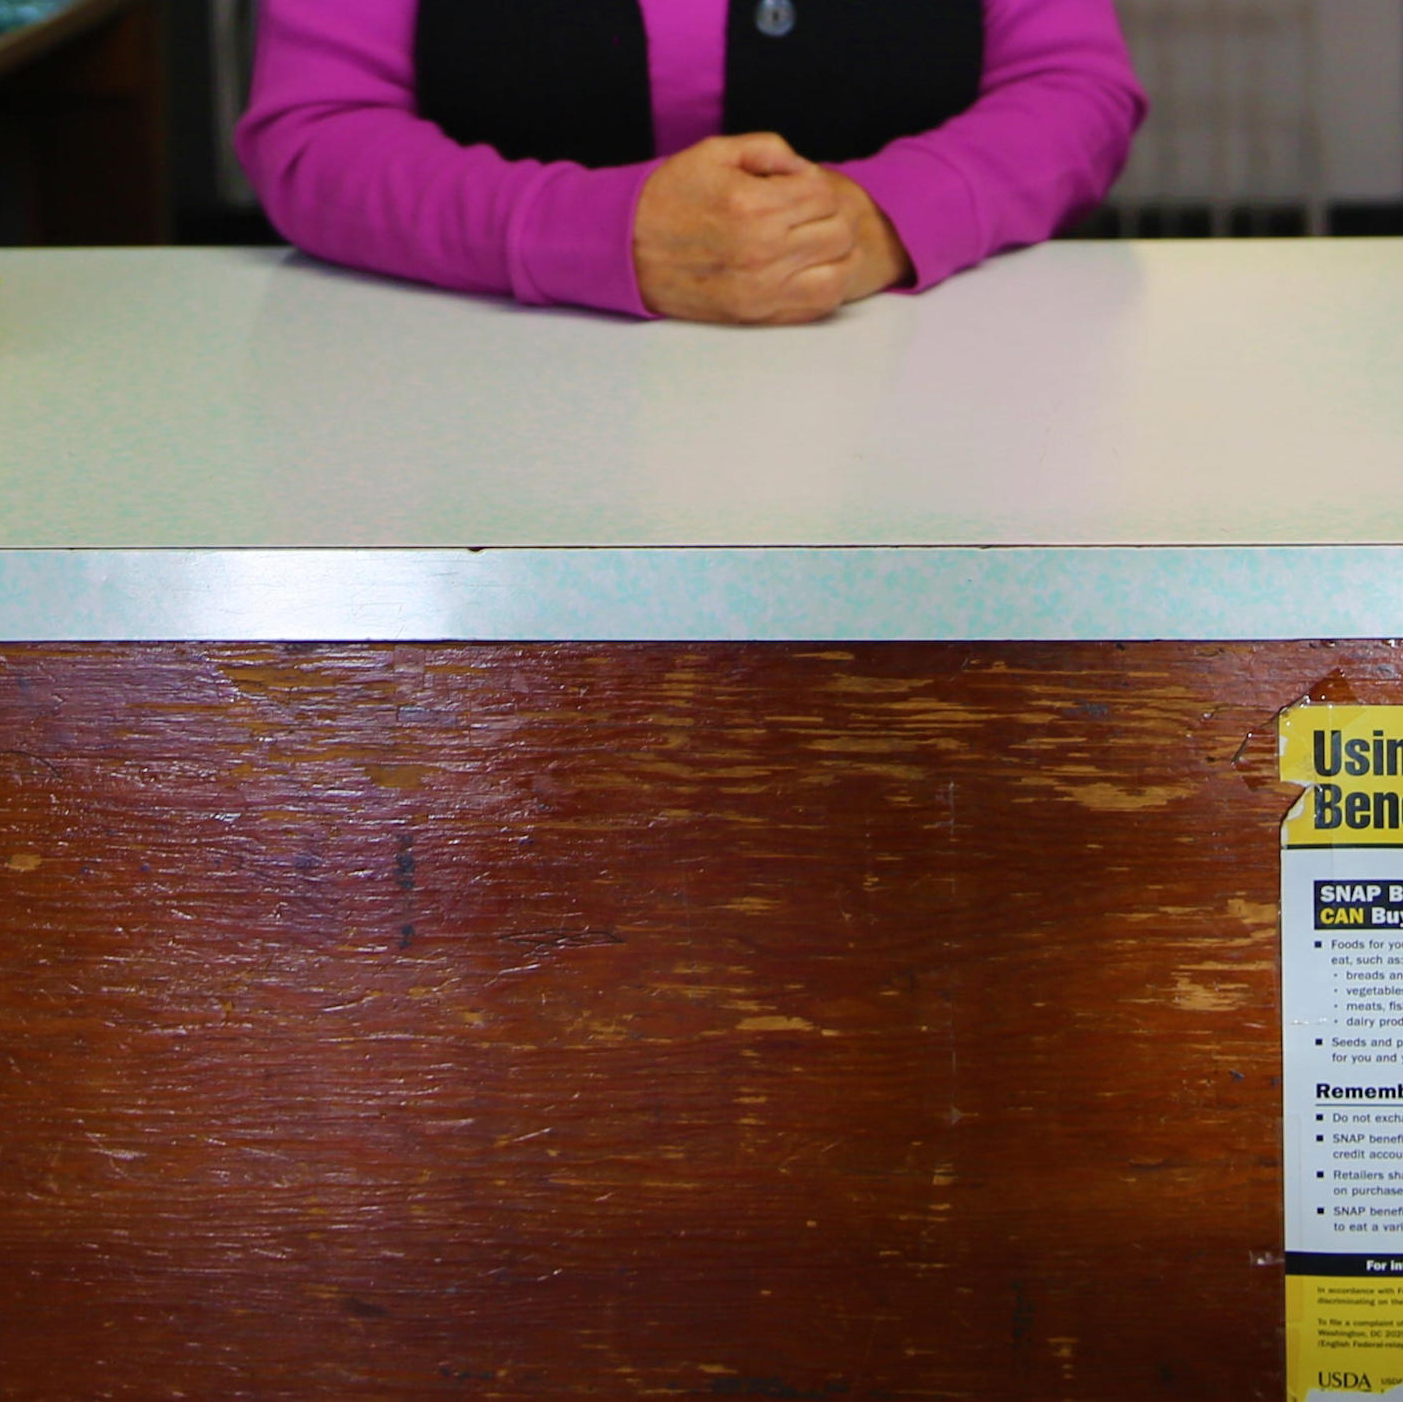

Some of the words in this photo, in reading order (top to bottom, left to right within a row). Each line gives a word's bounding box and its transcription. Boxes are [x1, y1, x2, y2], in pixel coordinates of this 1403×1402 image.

[1321, 885, 1381, 902] SNAP
[1321, 908, 1363, 924] CAN
[1331, 939, 1365, 949] Foods
[1369, 940, 1384, 949] for
[1331, 956, 1352, 965] eat,
[1357, 955, 1383, 964] such
[1346, 971, 1385, 980] breads
[1333, 1113, 1348, 1123] Do
[1353, 1114, 1370, 1122] not
[1367, 1260, 1387, 1270] For
[1318, 1372, 1371, 1389] USDA
